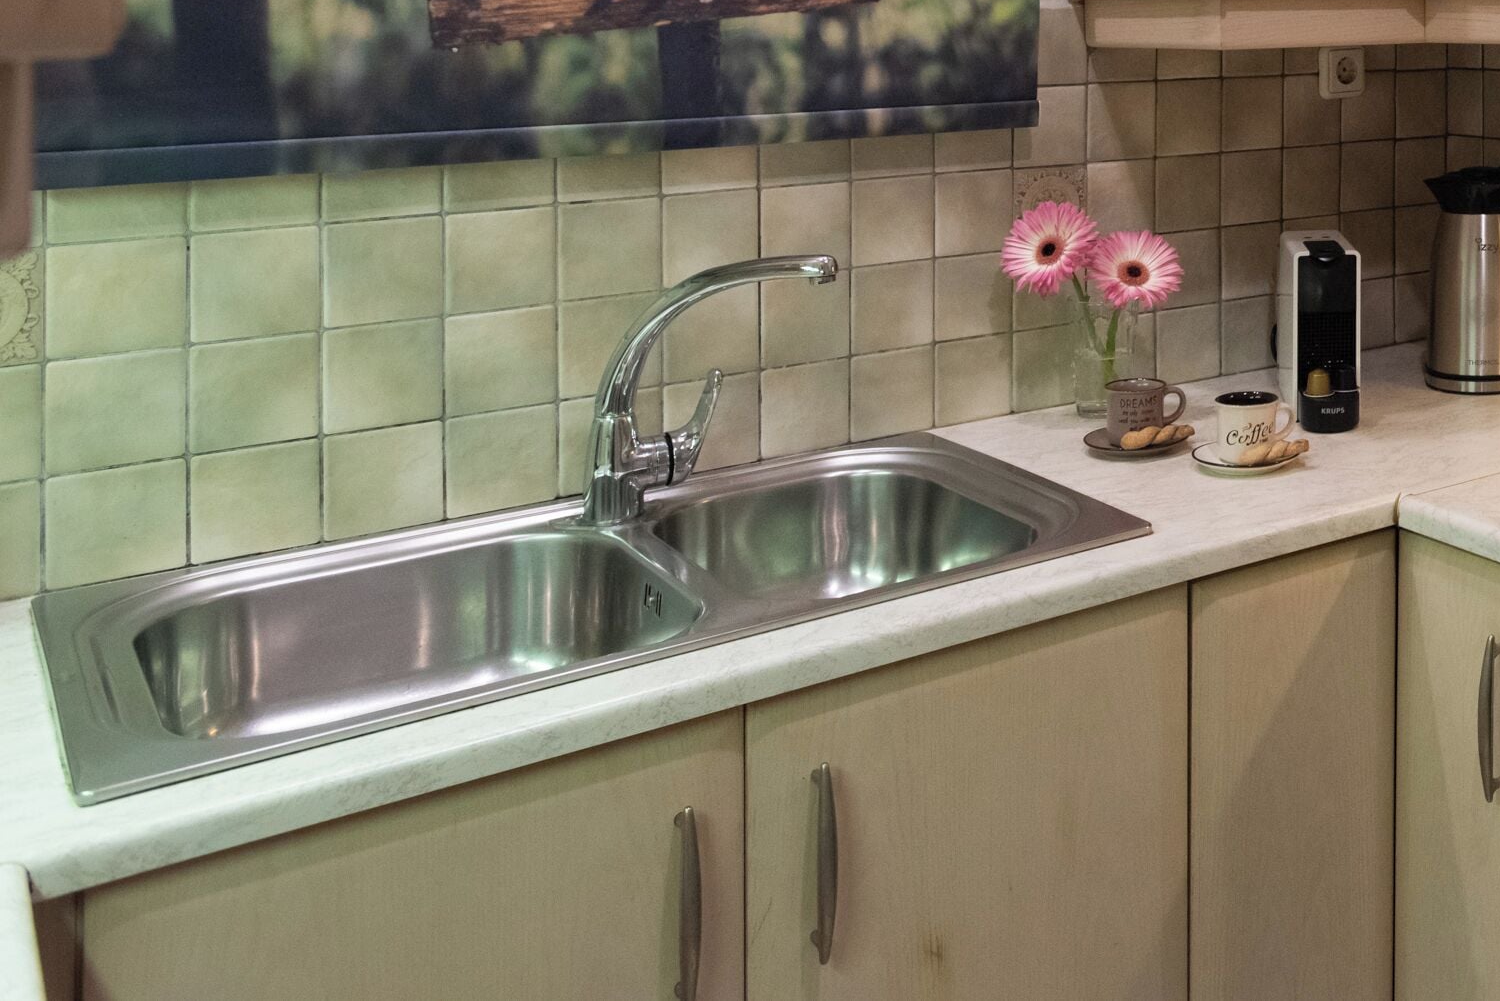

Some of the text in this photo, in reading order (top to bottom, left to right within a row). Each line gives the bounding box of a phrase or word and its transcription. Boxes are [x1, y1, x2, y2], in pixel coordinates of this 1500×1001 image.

[1119, 395, 1157, 409] DREAMS
[1320, 407, 1345, 415] KRUPS
[1226, 422, 1274, 446] Coffee
